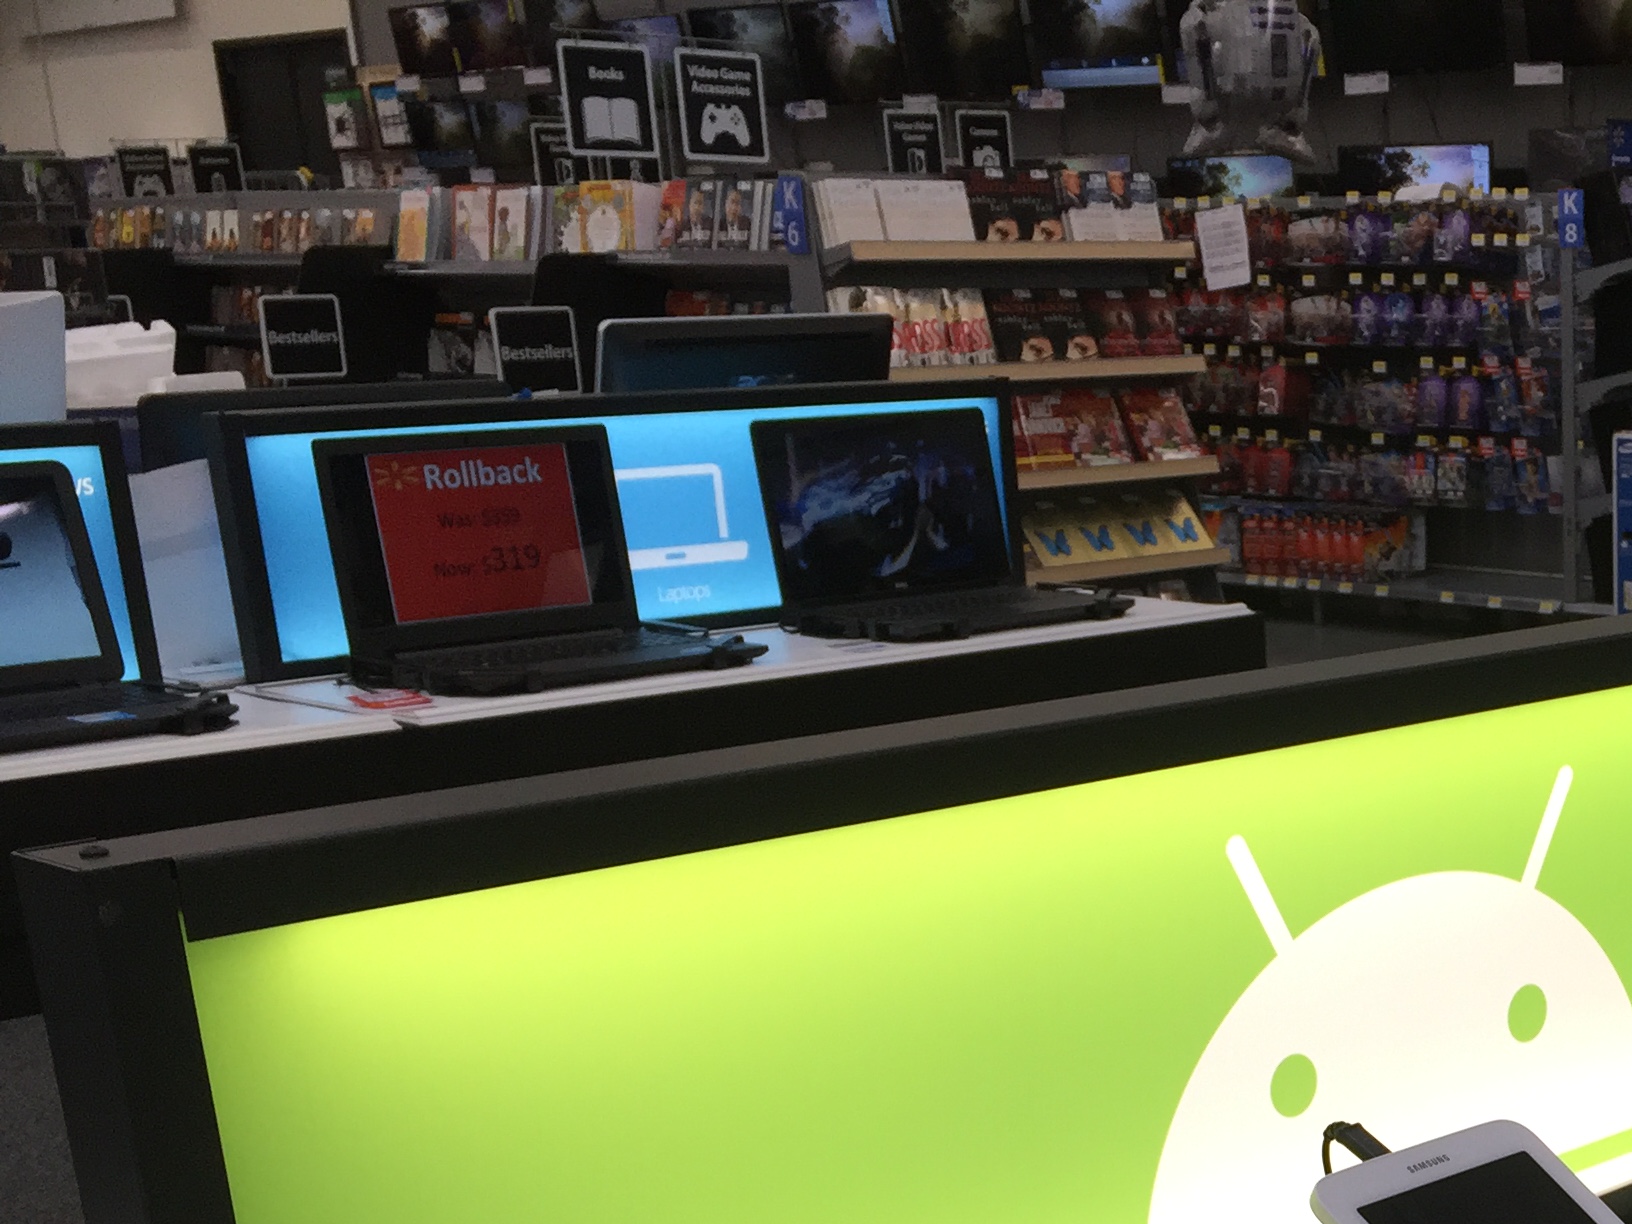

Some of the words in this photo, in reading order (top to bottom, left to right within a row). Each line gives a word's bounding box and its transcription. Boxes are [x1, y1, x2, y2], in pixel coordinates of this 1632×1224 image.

[587, 65, 625, 81] Books
[686, 64, 719, 79] Video
[720, 67, 752, 81] Game
[691, 80, 752, 96] Accessories
[783, 181, 799, 209] K
[1562, 191, 1578, 214] K
[787, 221, 799, 246] 6
[1564, 223, 1579, 243] 8
[268, 329, 339, 345] Bestsellers
[501, 344, 573, 361] Bestsellers
[422, 456, 542, 491] Rollback
[658, 585, 712, 603] Laptops
[1406, 1154, 1451, 1174] SAMSUNG
